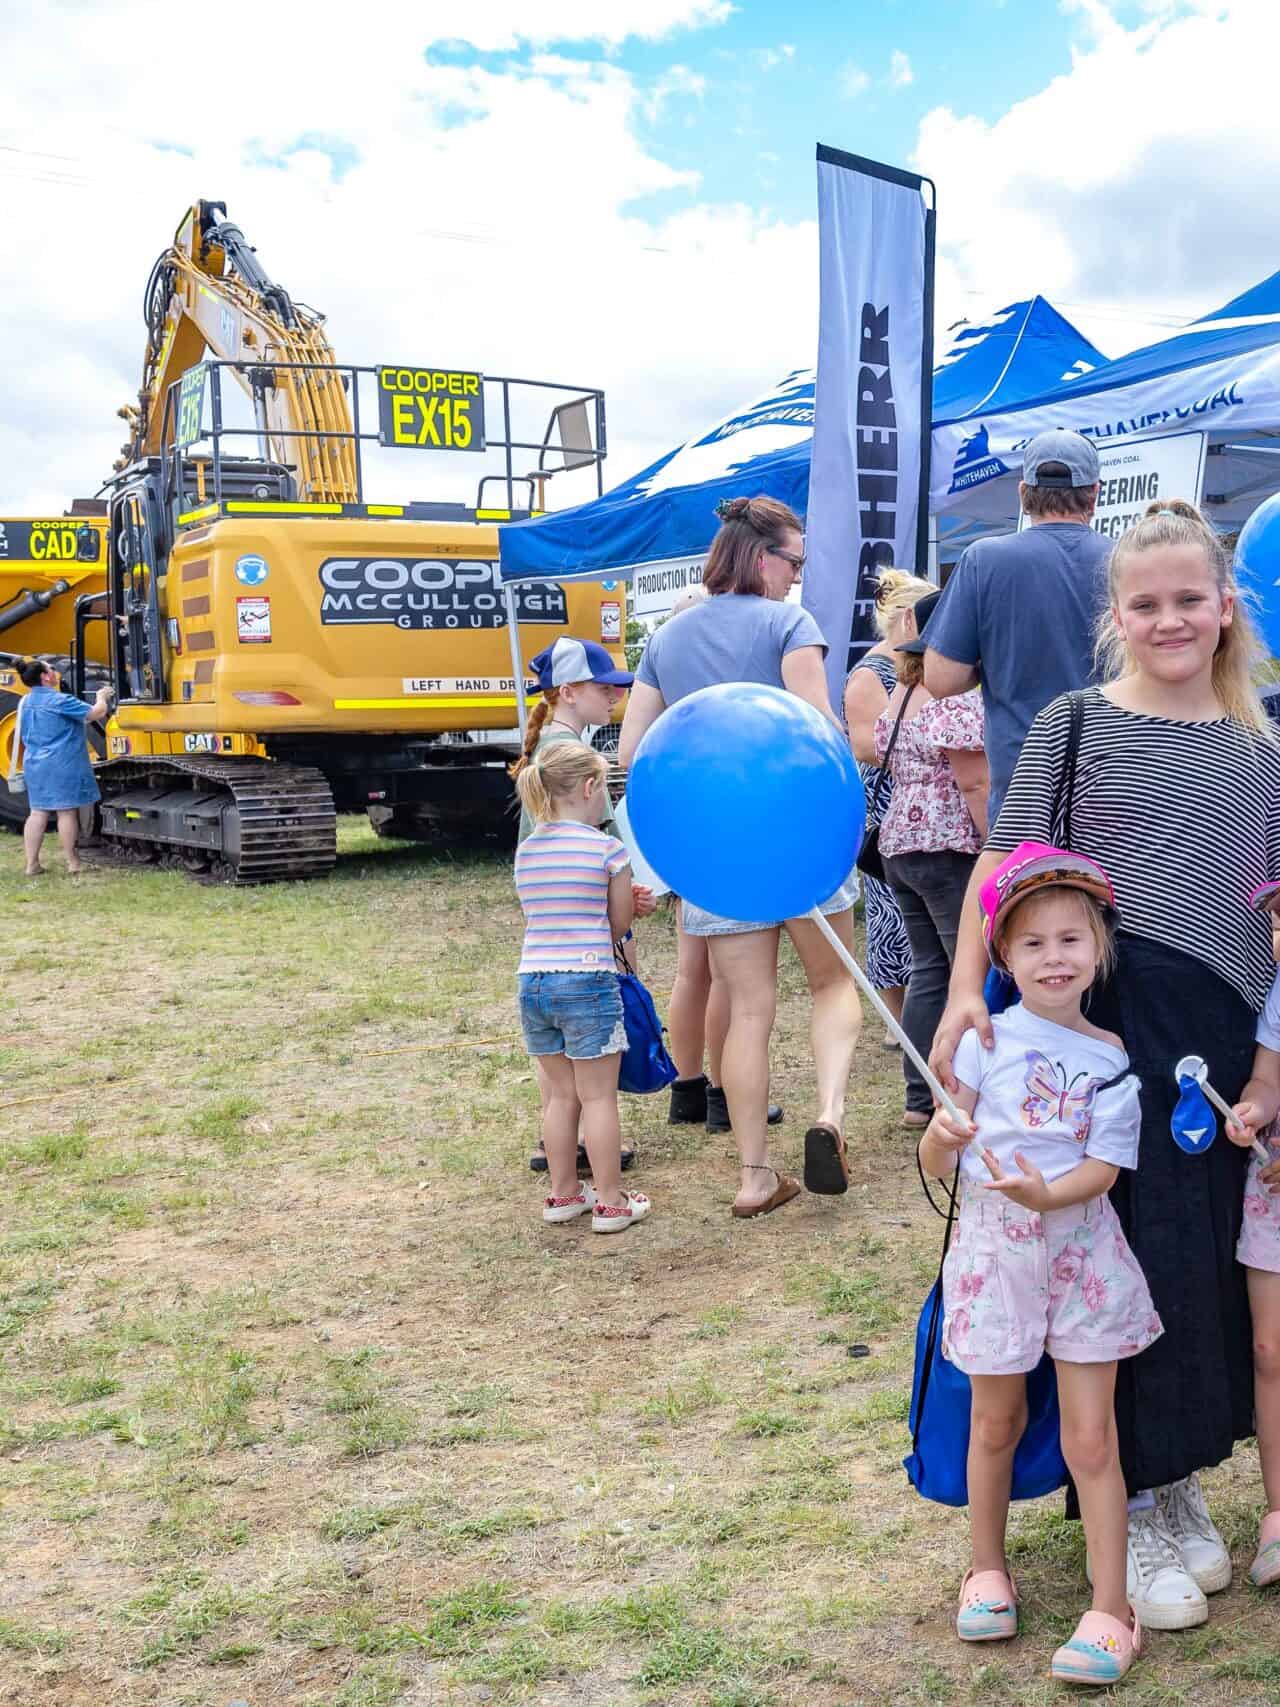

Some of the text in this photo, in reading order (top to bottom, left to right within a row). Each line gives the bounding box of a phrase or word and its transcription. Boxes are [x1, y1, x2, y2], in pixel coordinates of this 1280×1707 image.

[381, 368, 480, 396] COOPER
[393, 394, 472, 448] EX15
[953, 460, 1001, 488] WHITEHAVEN
[1096, 472, 1159, 507] EERING
[30, 530, 76, 560] CAD
[322, 560, 560, 591] COOP
[637, 567, 687, 596] PRODUCTION
[322, 593, 564, 611] MCCULLOUGH
[398, 614, 504, 628] GROUP
[411, 679, 535, 692] LEFT HAND DRVE
[184, 733, 214, 753] CAT
